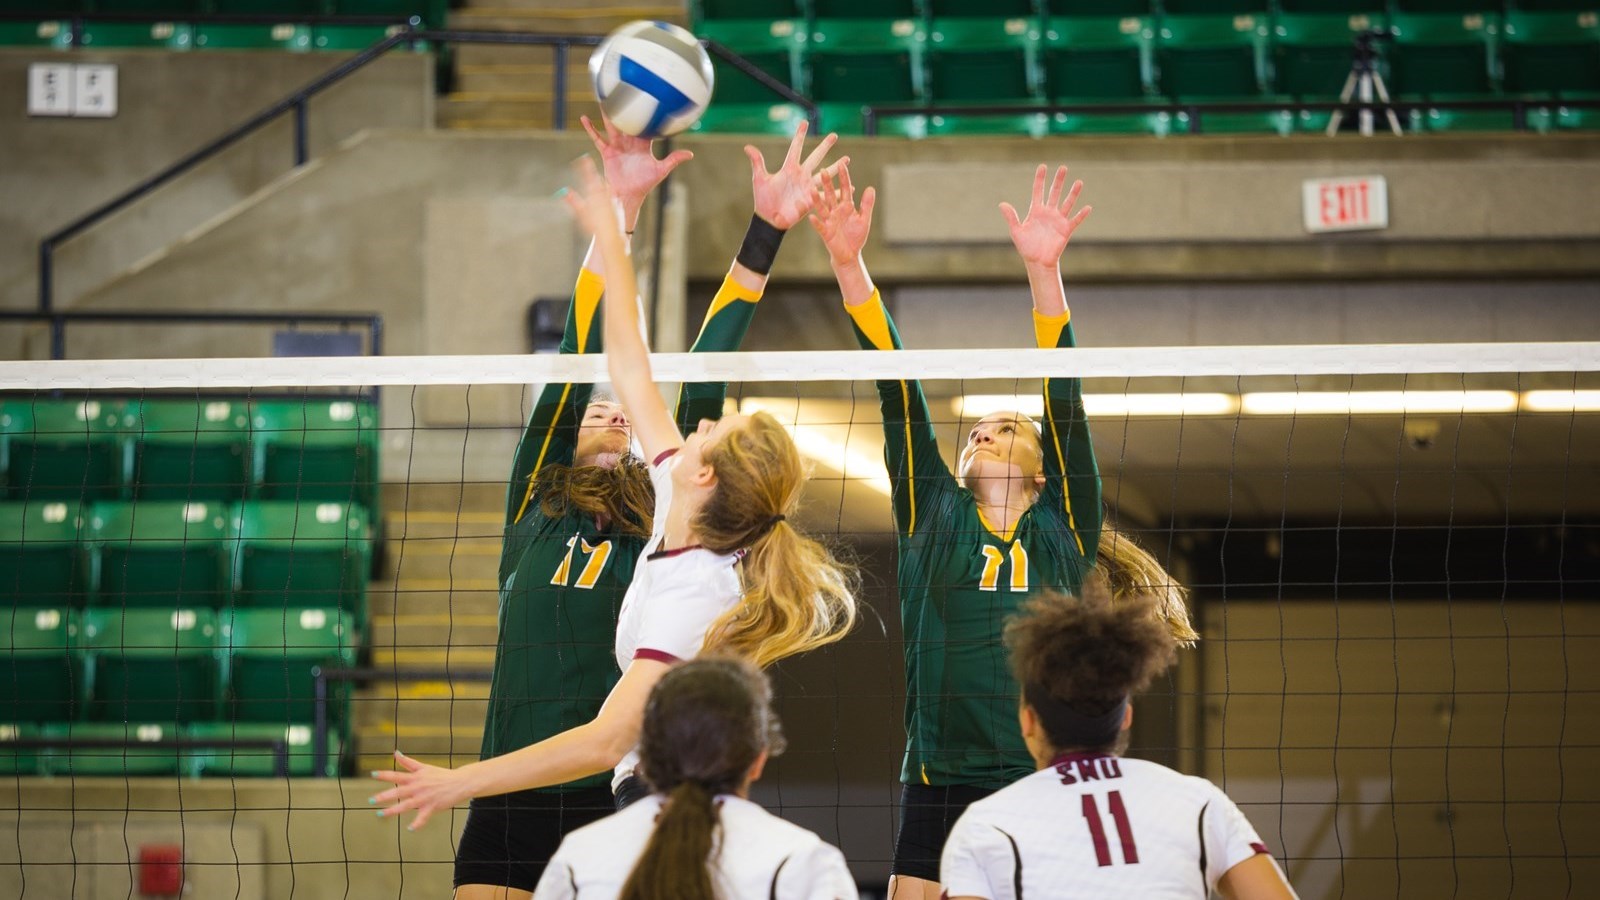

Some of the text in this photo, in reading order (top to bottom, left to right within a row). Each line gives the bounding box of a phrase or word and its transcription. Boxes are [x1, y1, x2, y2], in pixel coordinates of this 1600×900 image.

[1319, 180, 1372, 226] EXIT
[550, 532, 612, 589] 17
[1081, 791, 1139, 866] 11
